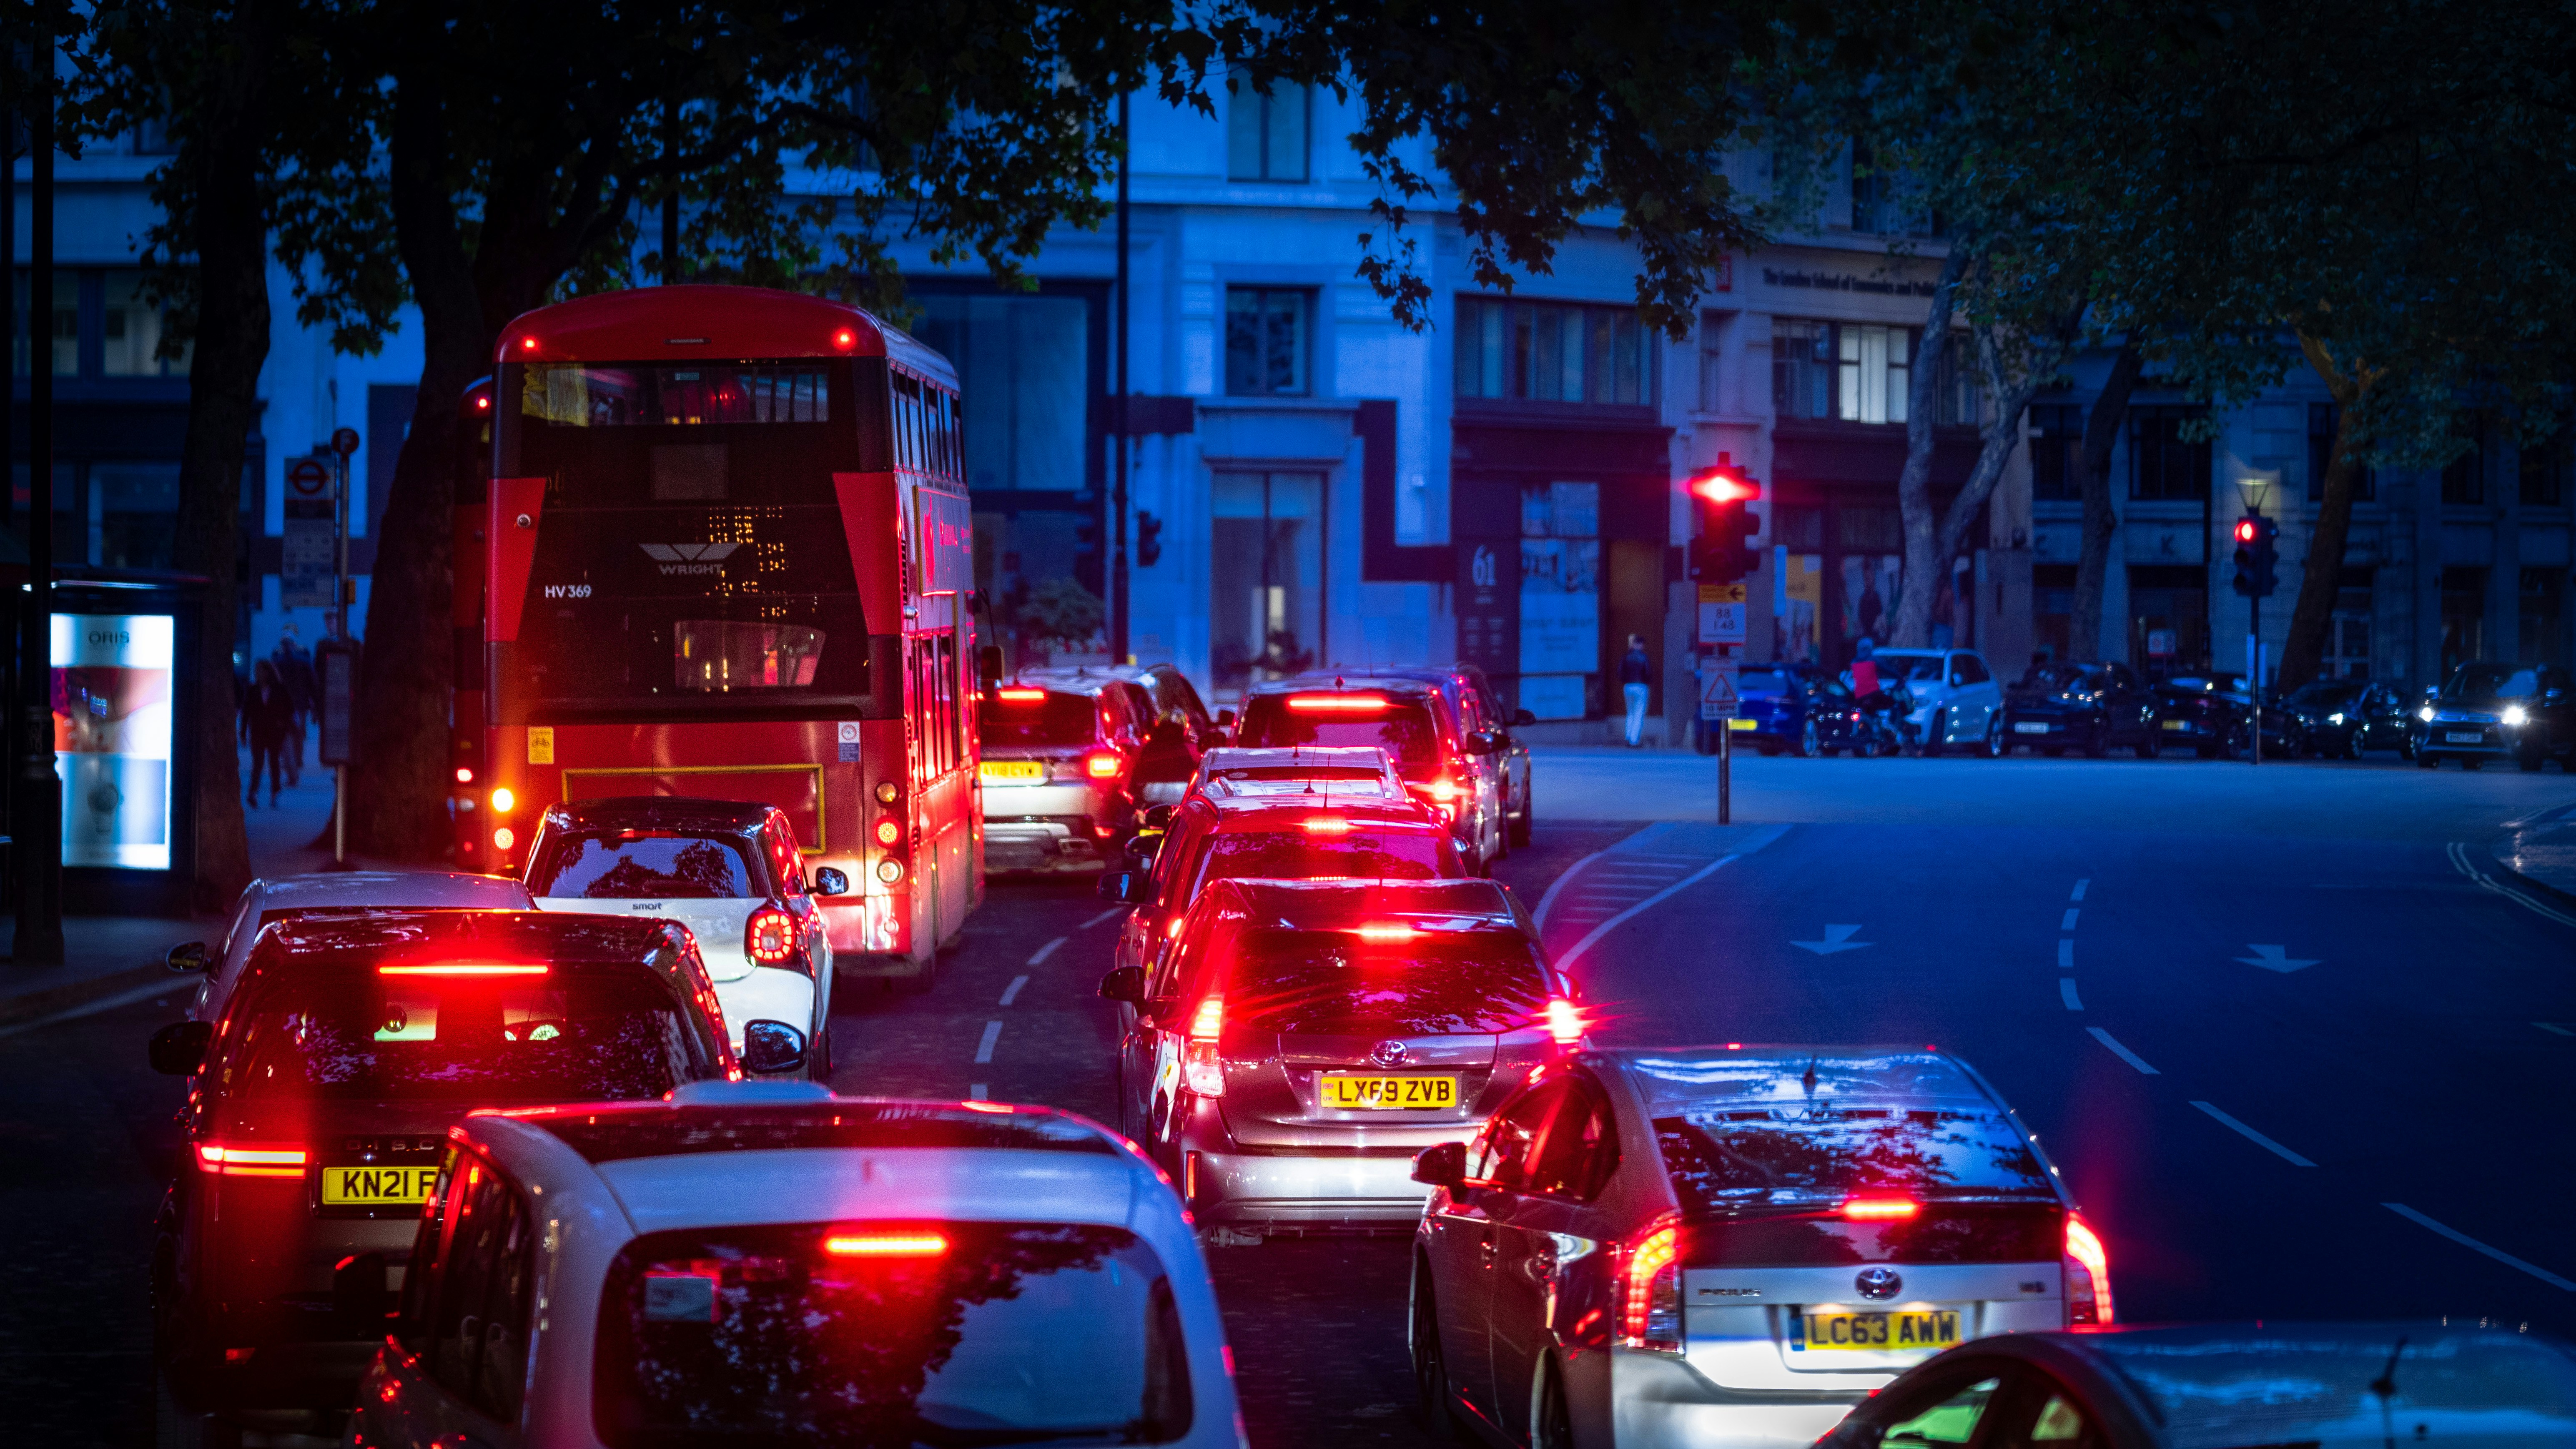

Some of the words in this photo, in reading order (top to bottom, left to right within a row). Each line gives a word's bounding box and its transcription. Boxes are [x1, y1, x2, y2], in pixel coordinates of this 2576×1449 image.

[658, 564, 723, 576] WRIGHT
[1472, 544, 1497, 587] 61
[545, 585, 566, 599] HV
[567, 584, 592, 599] 369
[1716, 608, 1731, 619] 88
[1713, 620, 1735, 630] 148
[88, 631, 130, 645] ORIS
[632, 902, 662, 910] smart
[1339, 1080, 1398, 1102] LX69
[1405, 1080, 1450, 1102] ZVB
[343, 1171, 408, 1198] KN21
[1810, 1314, 1888, 1345] LC63
[1899, 1313, 1955, 1343] AWW
